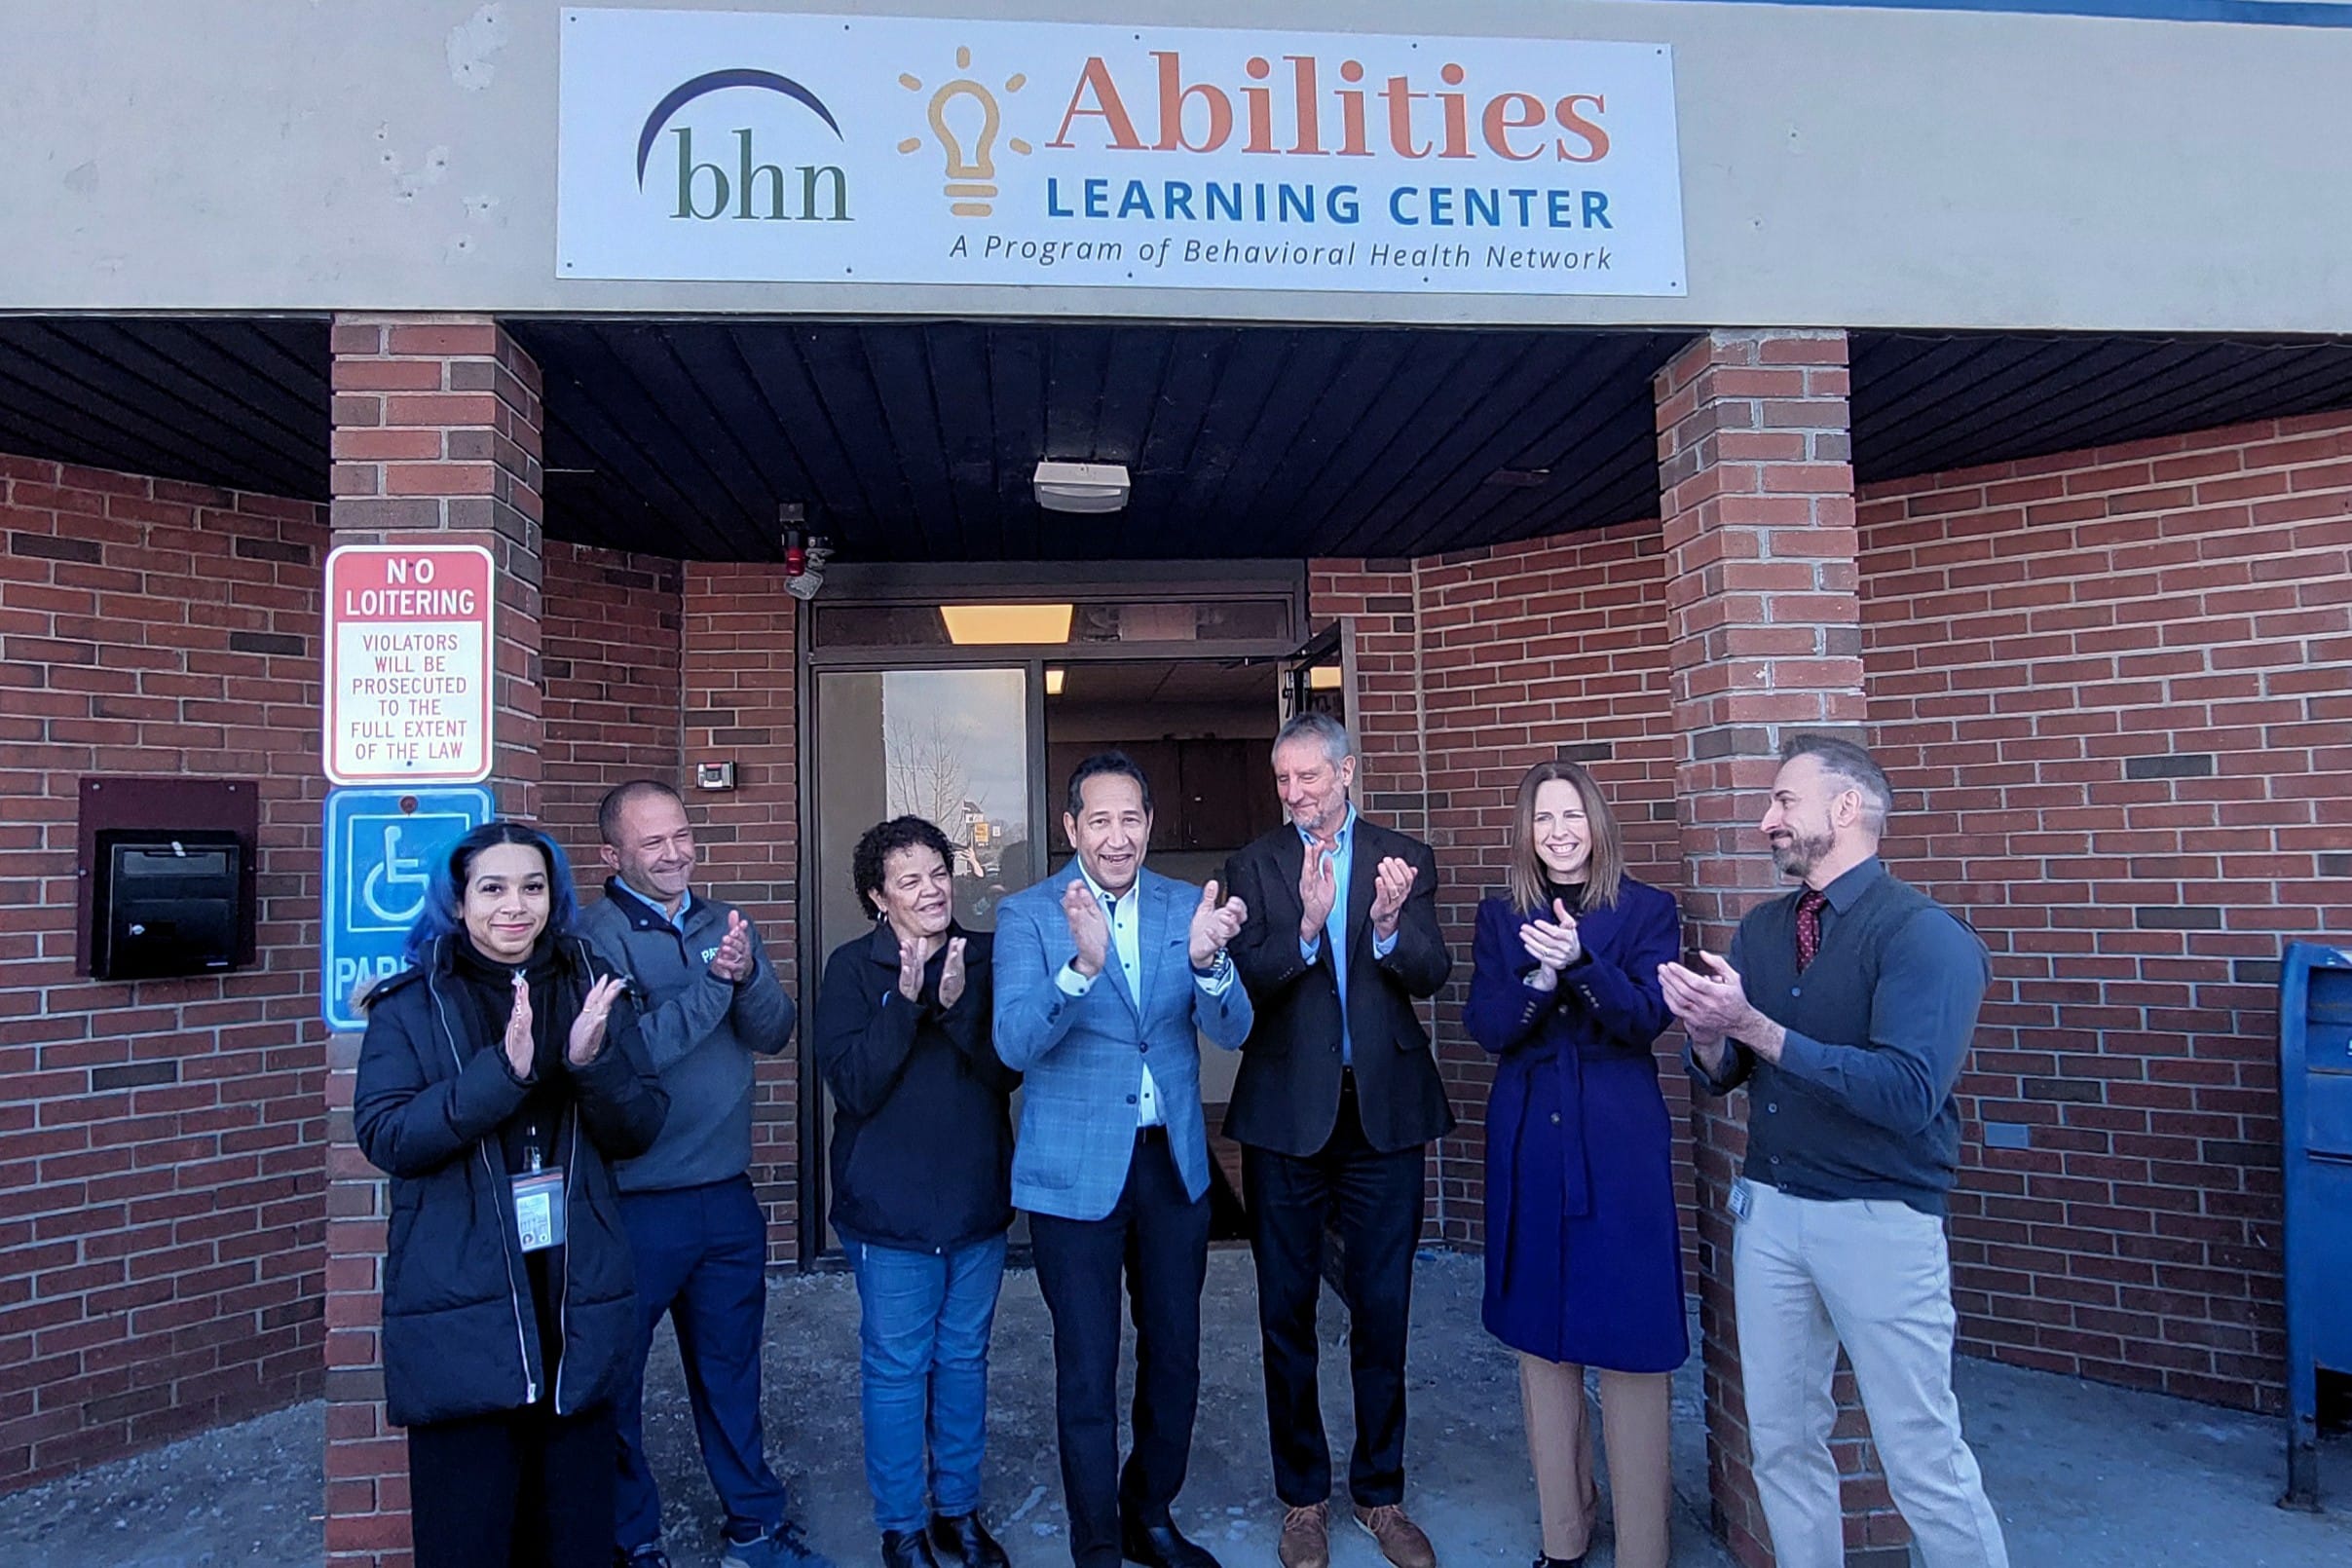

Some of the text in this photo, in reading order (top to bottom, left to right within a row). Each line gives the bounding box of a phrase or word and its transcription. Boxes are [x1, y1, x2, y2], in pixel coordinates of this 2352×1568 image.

[1045, 51, 1610, 163] Abilities
[669, 127, 855, 221] bhn
[1047, 177, 1614, 229] LEARNING CENTER
[950, 235, 1612, 271] A Program of Behavioral Health Network
[387, 558, 434, 584] NO
[346, 589, 475, 616] LOITERING
[362, 634, 459, 652] VIOLATORS
[375, 655, 446, 673] WILL BE
[352, 677, 467, 694] PROSECUTED
[378, 699, 442, 716] TO THE
[352, 720, 467, 738] FULL EXTENT
[355, 742, 464, 760] OF THE LAW
